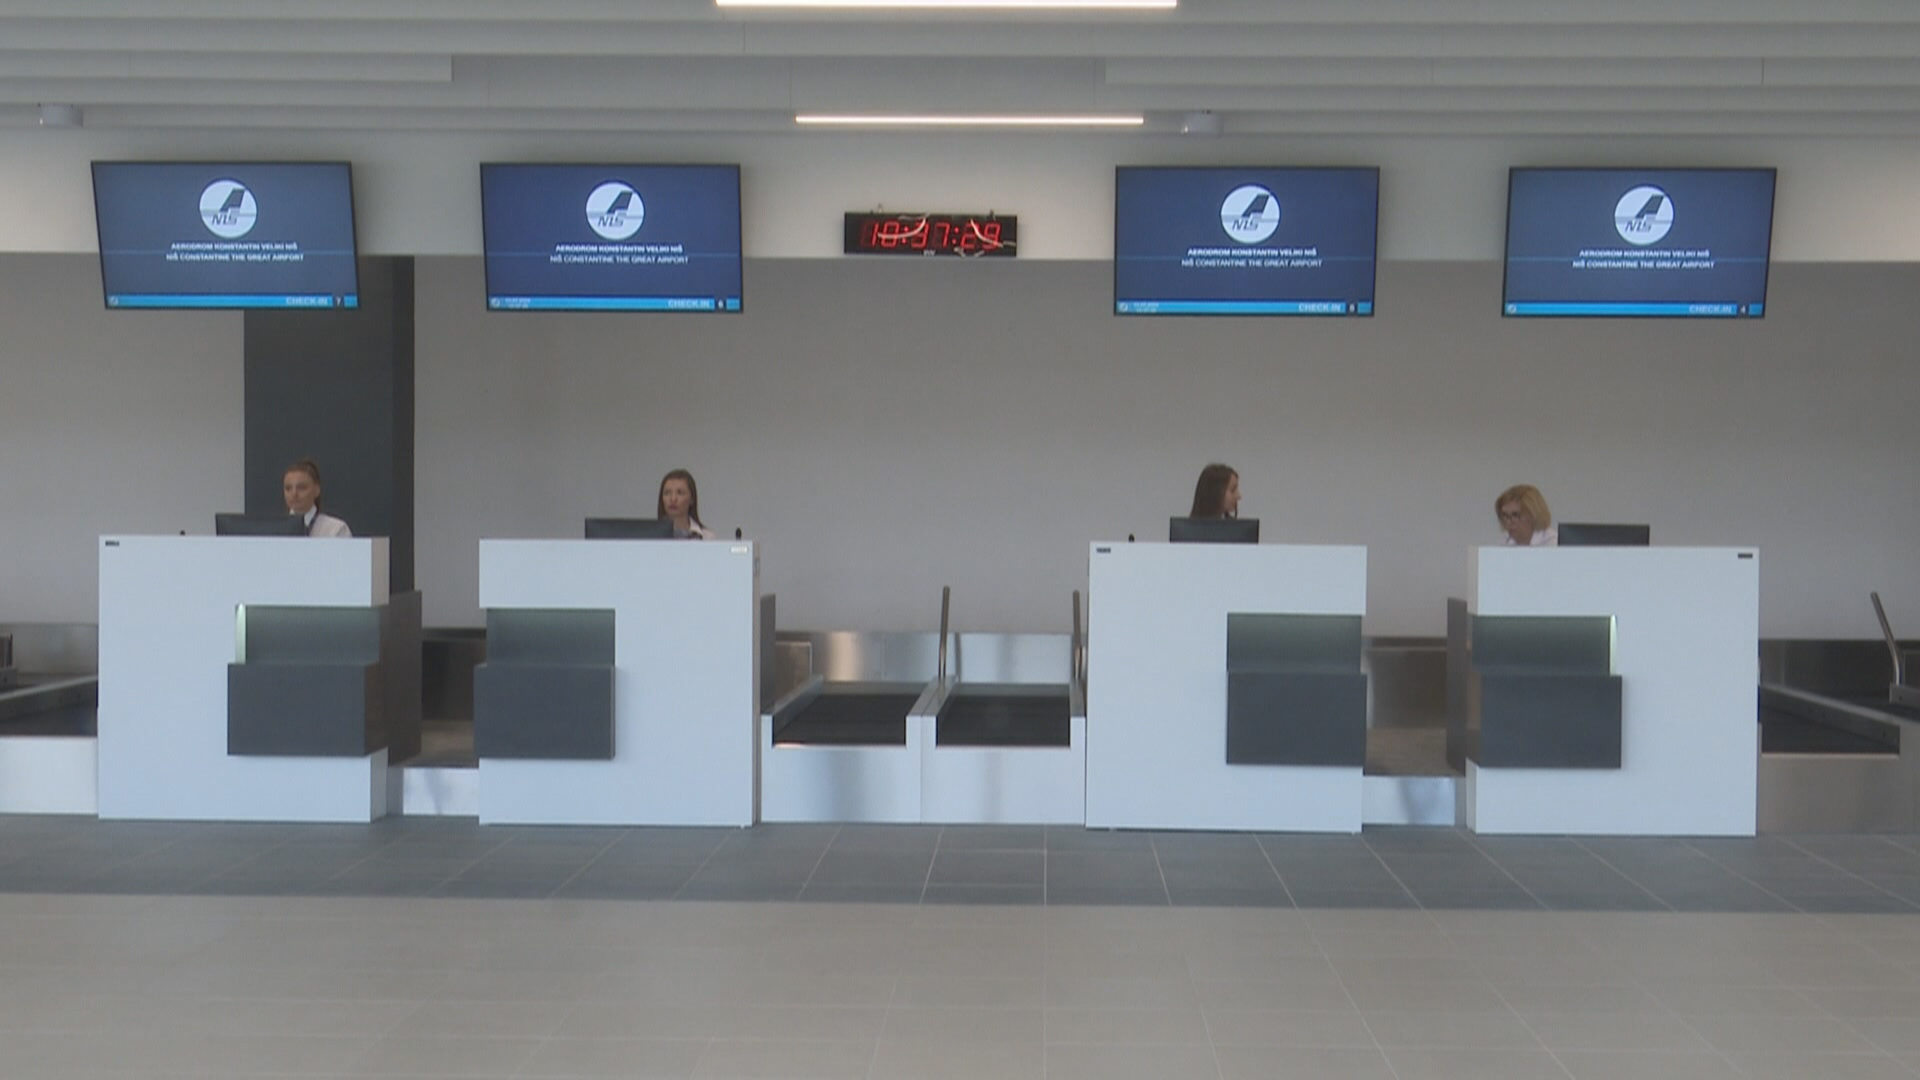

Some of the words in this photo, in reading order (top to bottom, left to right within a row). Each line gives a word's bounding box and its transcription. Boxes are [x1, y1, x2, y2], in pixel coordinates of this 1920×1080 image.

[179, 253, 230, 261] CONSTANTINE
[231, 253, 246, 261] THE
[246, 253, 271, 261] GREAT
[272, 253, 304, 261] AIRPORT
[563, 255, 614, 263] CONSTANTINE
[616, 255, 631, 263] THE
[631, 255, 656, 263] GREAT
[656, 255, 688, 263] AIRPORT
[1195, 259, 1245, 267] CONSTANTINE
[1248, 259, 1263, 267] THE
[1263, 259, 1289, 267] GREAT
[1289, 259, 1322, 267] AIRPORT
[1586, 260, 1638, 268] CONSTANTINE
[1640, 260, 1654, 268] THE
[1655, 260, 1681, 268] GREAT
[1681, 260, 1715, 268] AIRPORT
